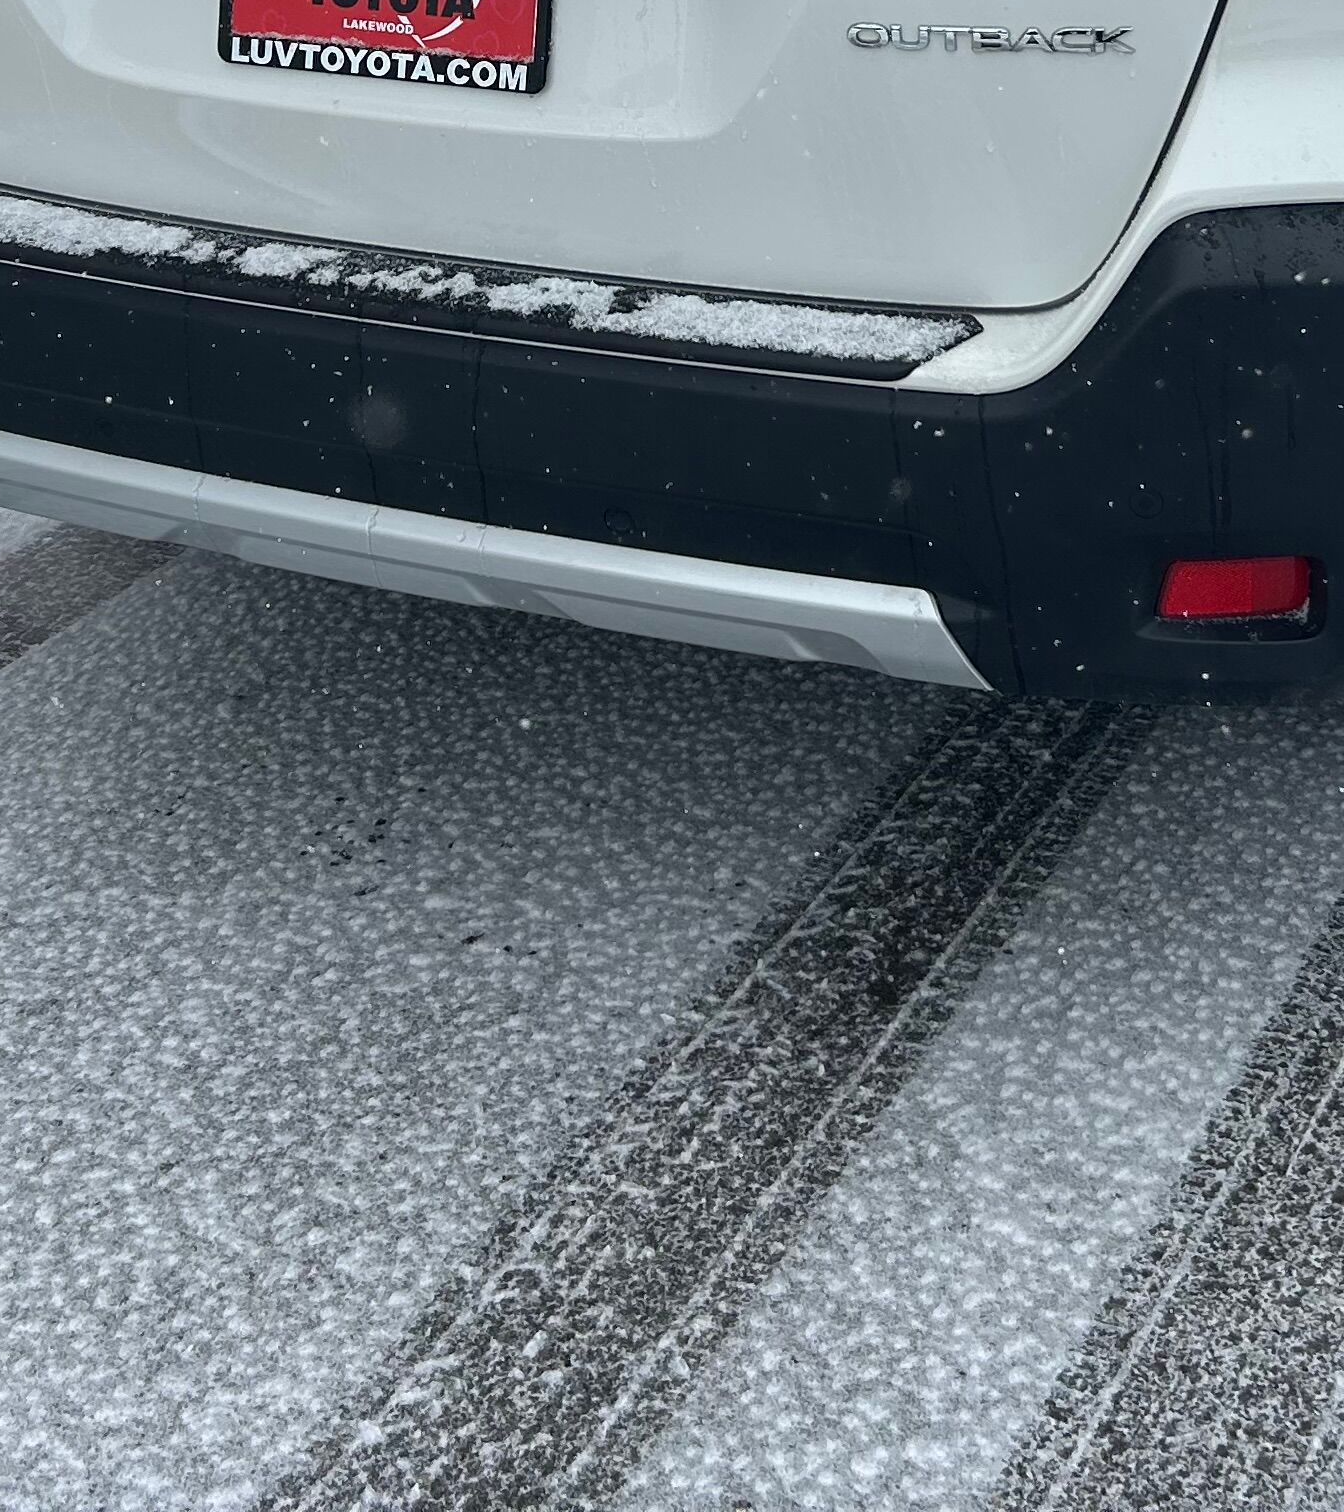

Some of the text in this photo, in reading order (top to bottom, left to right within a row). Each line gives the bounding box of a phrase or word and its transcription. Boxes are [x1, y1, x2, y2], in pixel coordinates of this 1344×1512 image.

[342, 17, 415, 35] LAKEWOOD
[846, 21, 1136, 55] OUTBACK
[230, 36, 528, 92] LUVTOYOTA.COM
